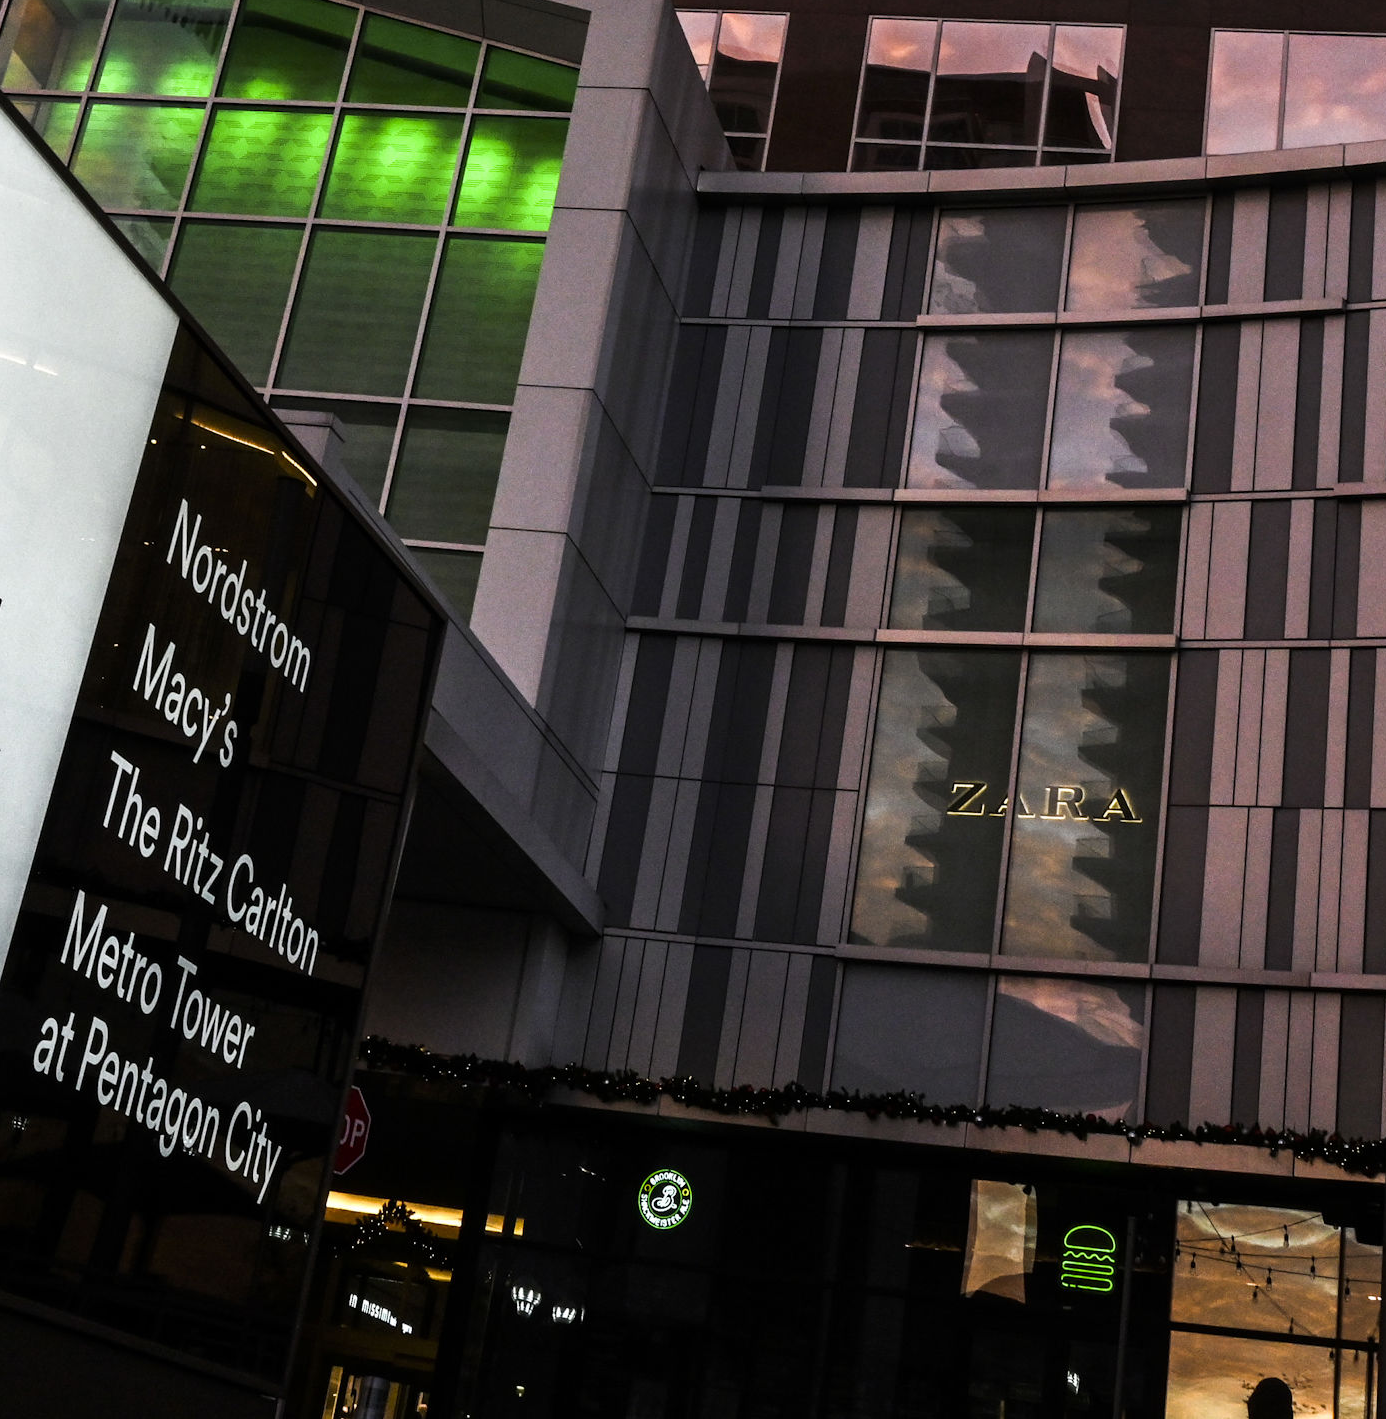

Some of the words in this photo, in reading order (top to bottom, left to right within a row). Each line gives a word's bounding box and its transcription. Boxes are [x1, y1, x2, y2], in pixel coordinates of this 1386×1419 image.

[166, 498, 312, 693] Nordstrom
[132, 622, 238, 768] Macy's
[102, 749, 161, 858] The
[163, 803, 224, 905] Ritz
[226, 853, 319, 976] Carlton
[946, 781, 1143, 823] ZARA
[60, 889, 163, 1015] Metro
[170, 954, 256, 1070] Tower
[33, 1011, 76, 1082] at
[76, 1016, 220, 1159] Pentagon
[225, 1101, 283, 1205] City
[649, 1172, 686, 1188] BROOKLYN
